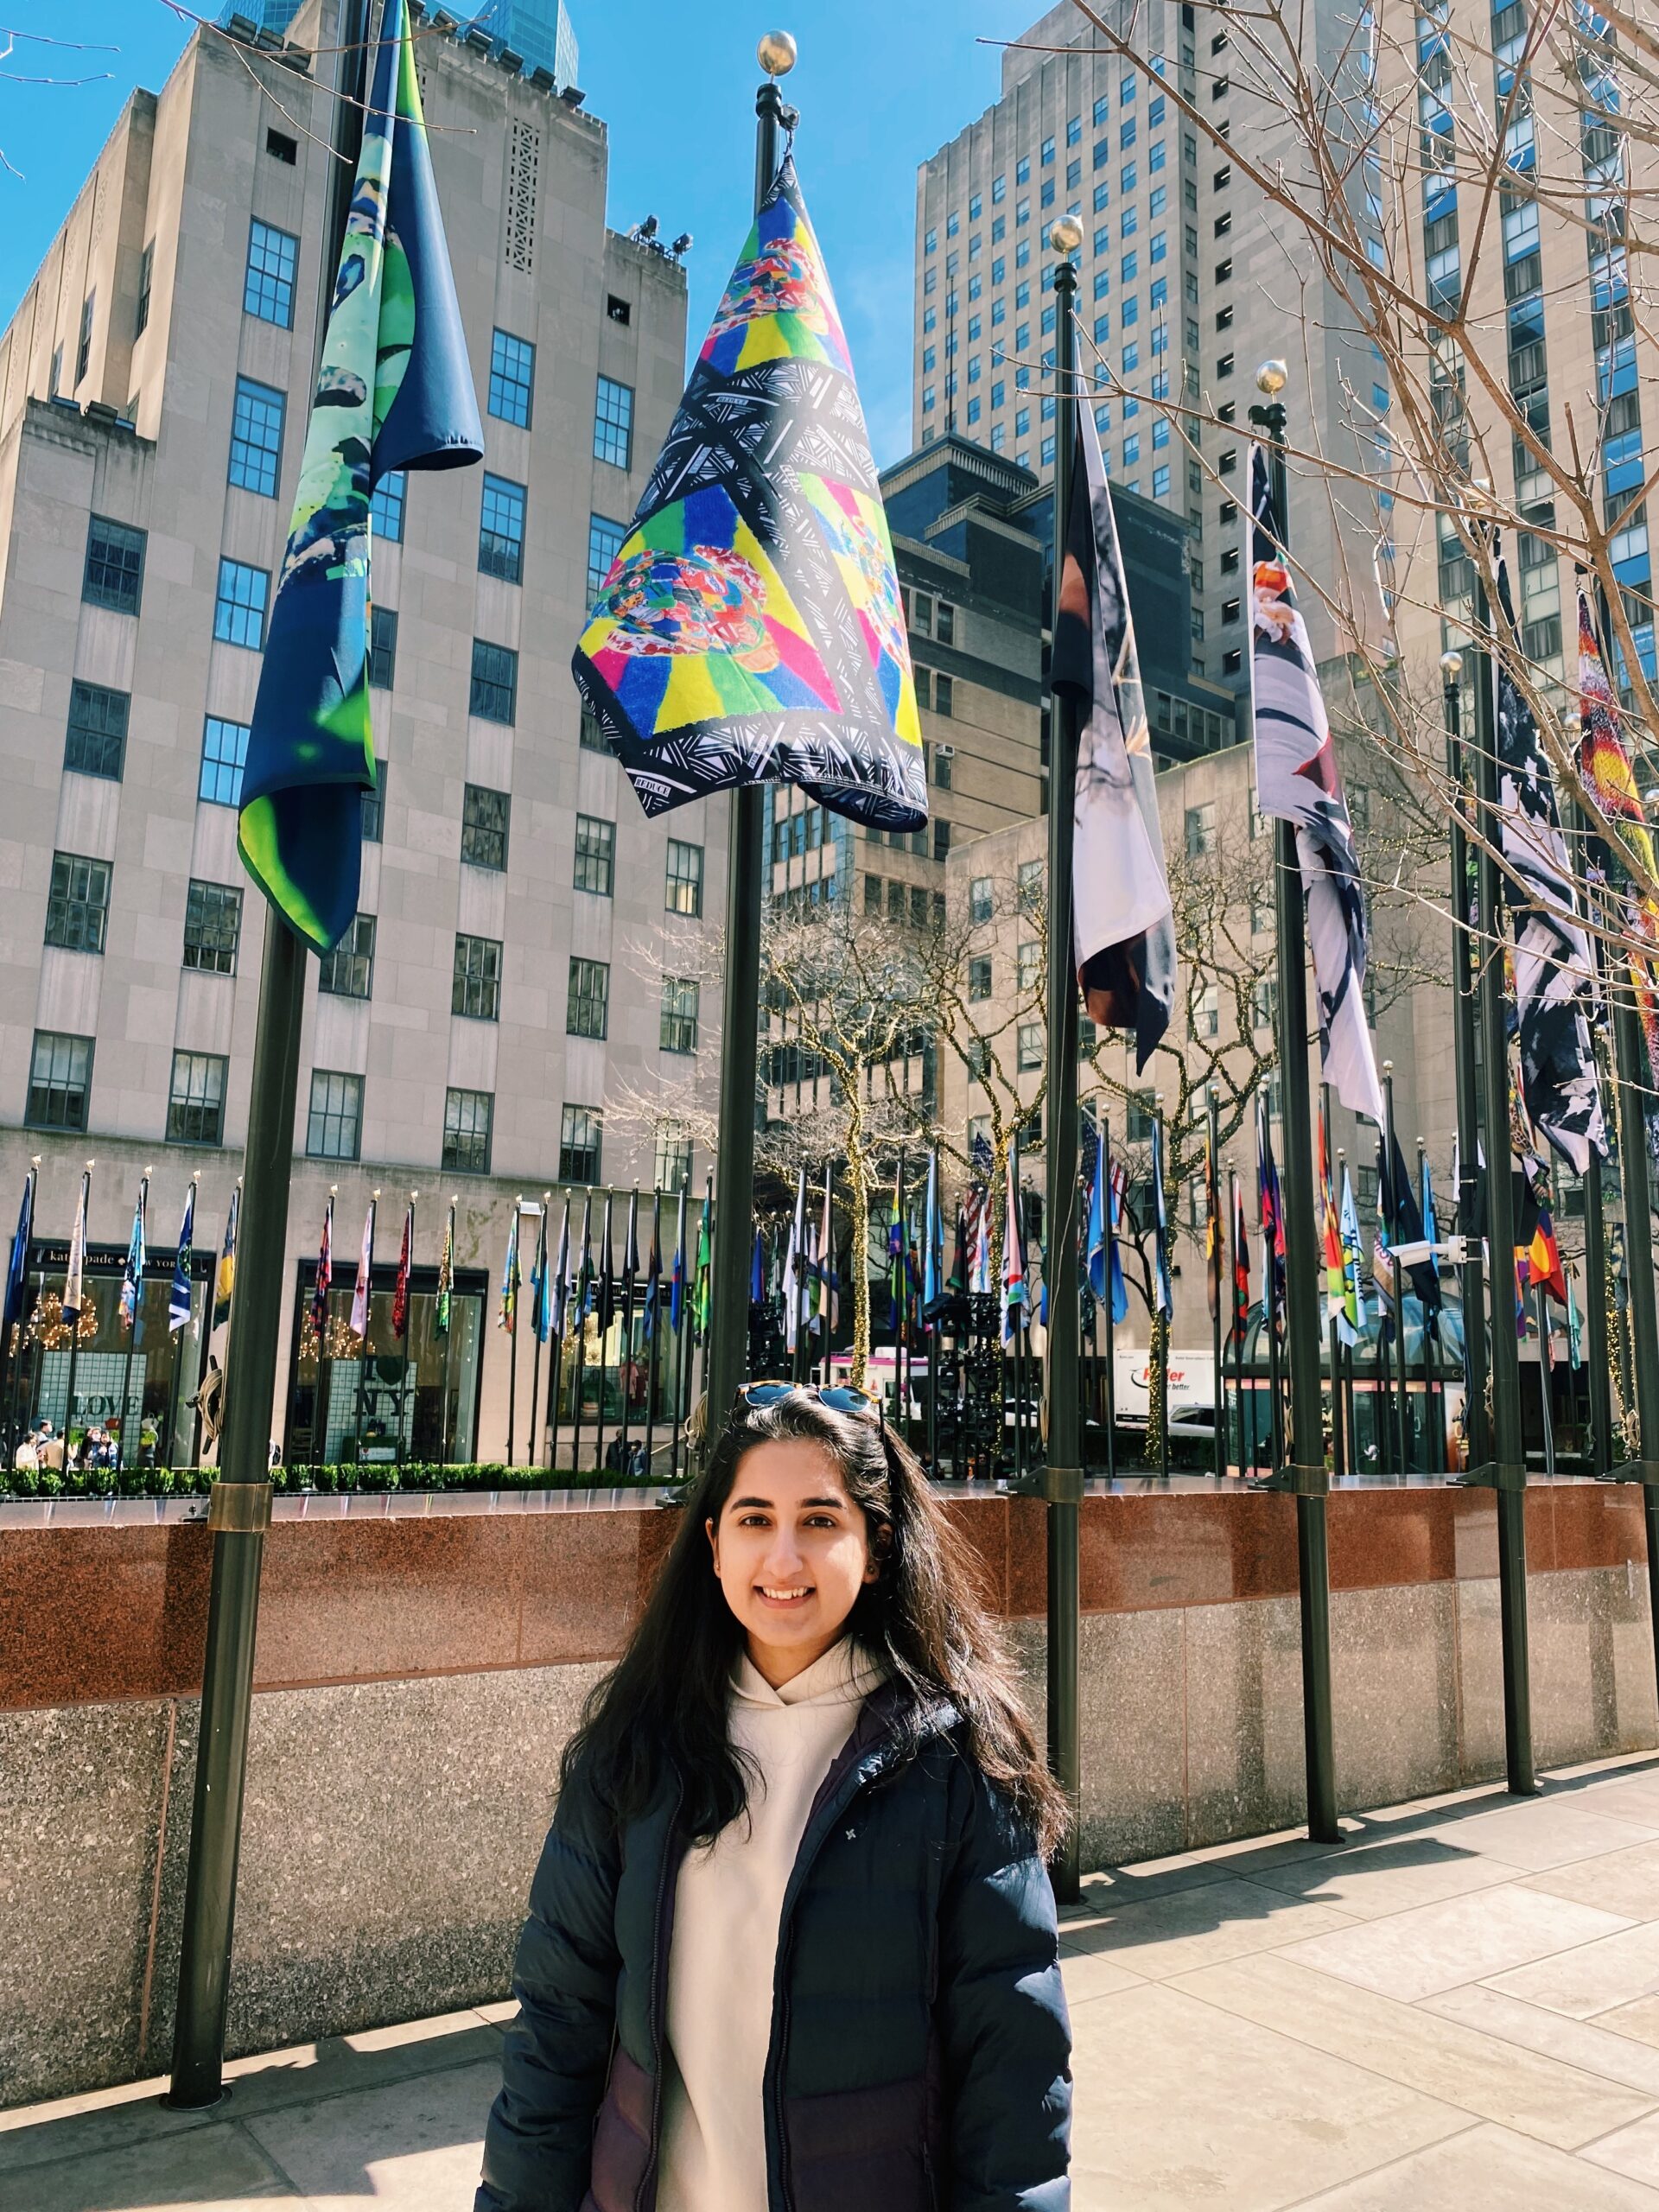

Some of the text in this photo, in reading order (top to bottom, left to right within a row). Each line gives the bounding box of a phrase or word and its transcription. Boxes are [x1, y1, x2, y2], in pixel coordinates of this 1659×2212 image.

[635, 778, 670, 796] REDUCE
[85, 1255, 114, 1265] pade
[156, 1259, 175, 1268] YOR
[1143, 1367, 1185, 1382] Rer
[71, 1395, 139, 1415] LOVE
[352, 1389, 414, 1416] NY
